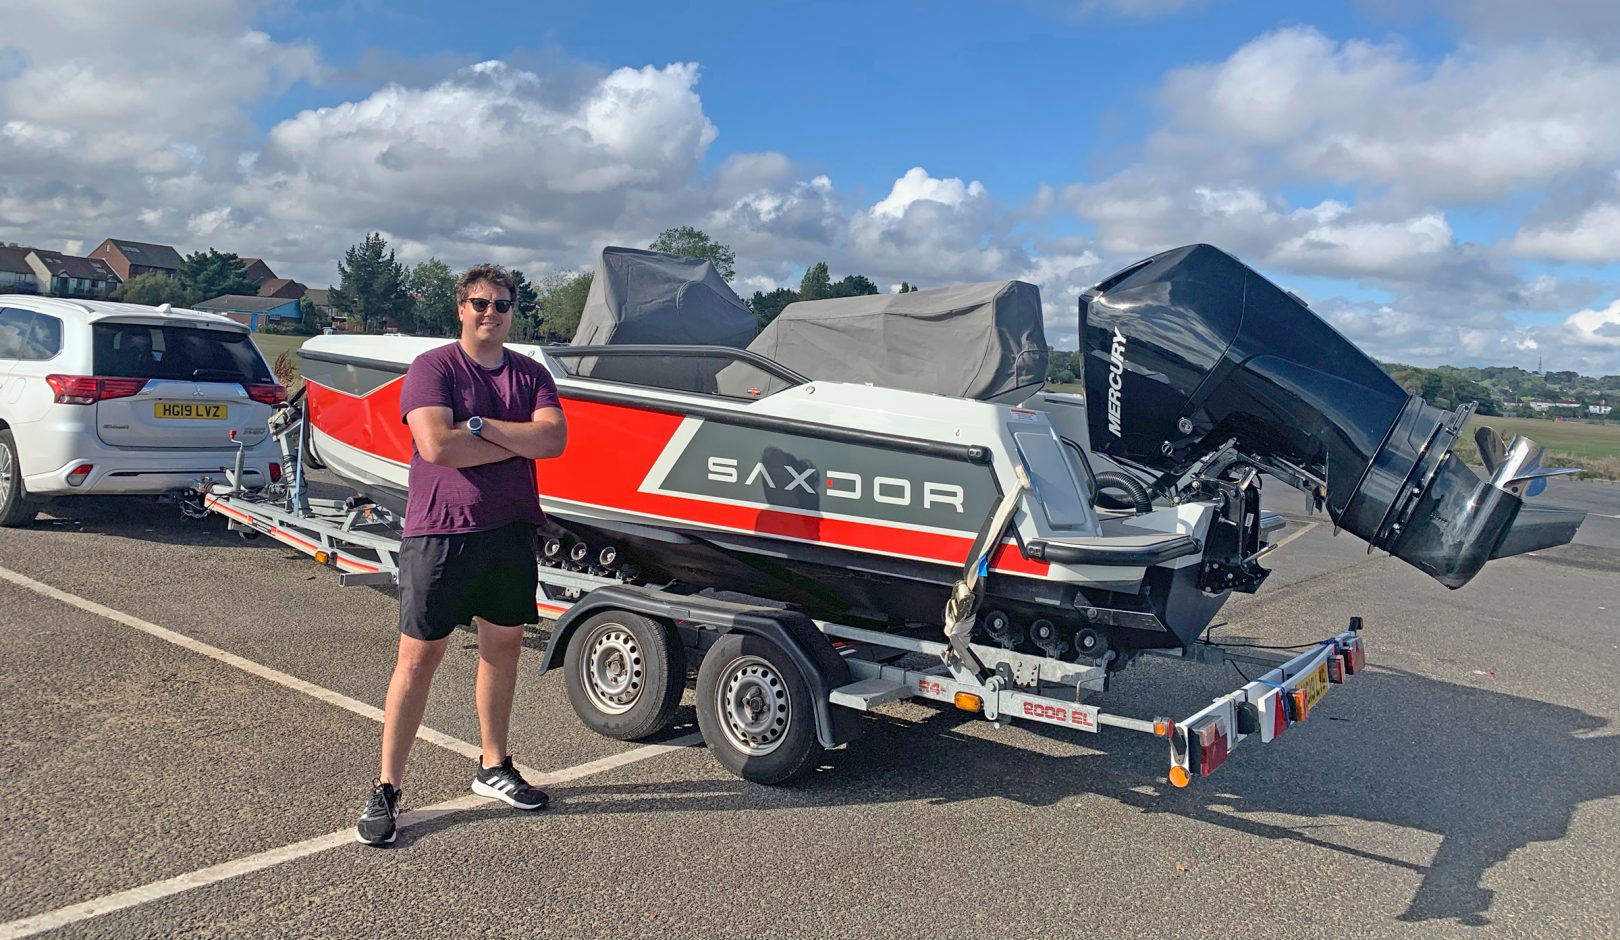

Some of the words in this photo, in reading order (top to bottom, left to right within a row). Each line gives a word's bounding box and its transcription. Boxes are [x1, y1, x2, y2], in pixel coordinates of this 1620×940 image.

[1108, 326, 1127, 438] MERCURY
[163, 404, 192, 417] HG19
[196, 405, 220, 418] LVZ
[707, 456, 965, 513] SAXDOR
[1023, 701, 1067, 722] 2000
[1071, 710, 1093, 727] EL
